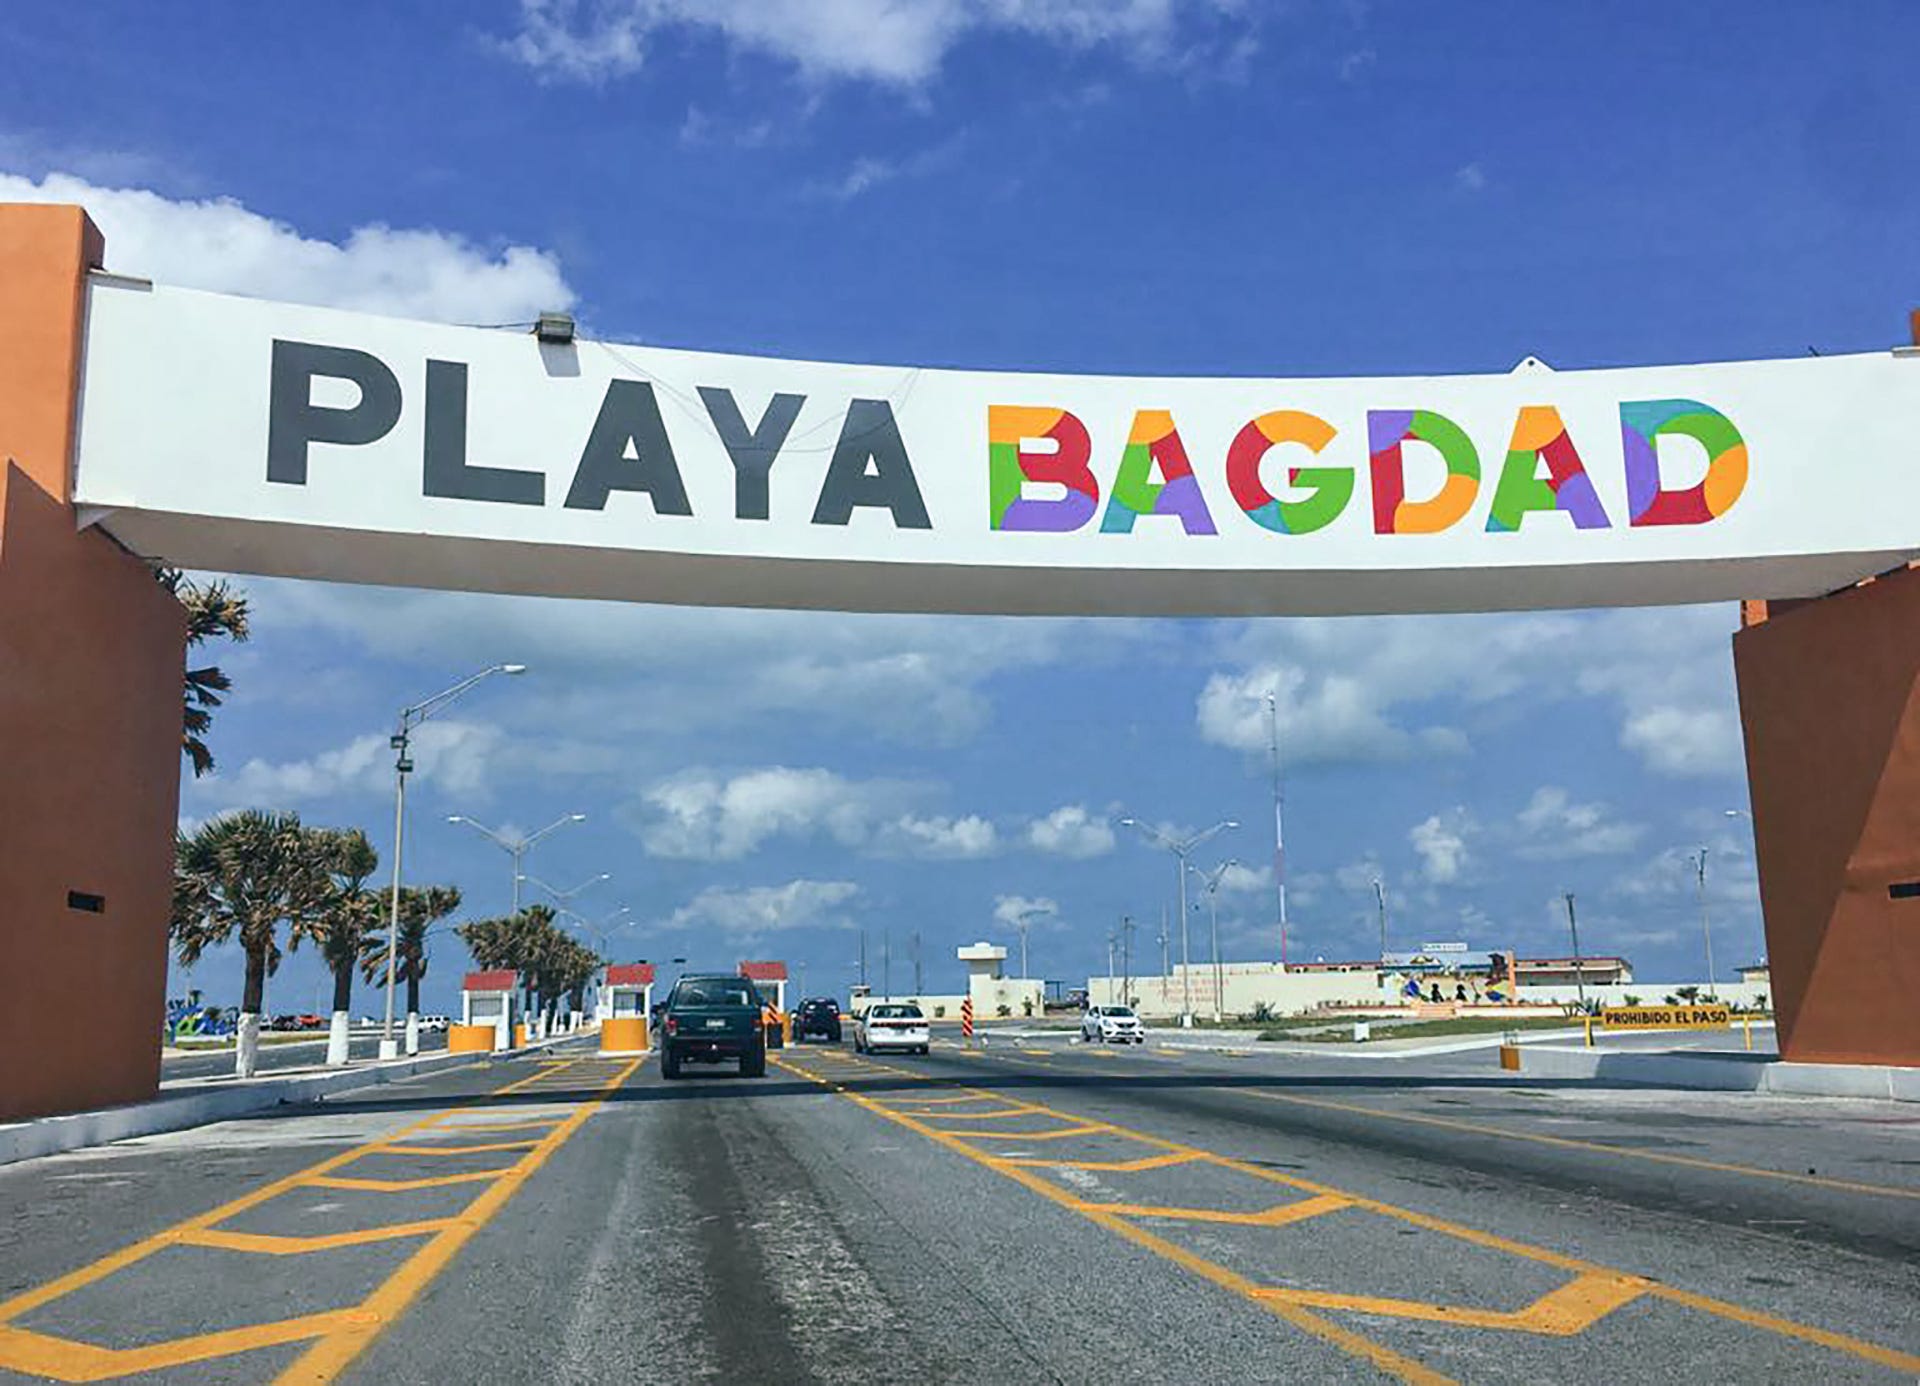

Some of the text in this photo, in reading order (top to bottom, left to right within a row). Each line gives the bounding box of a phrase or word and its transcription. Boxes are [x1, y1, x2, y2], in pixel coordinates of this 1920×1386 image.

[267, 338, 1749, 536] PLAYA BAGDAD
[1605, 1010, 1727, 1024] PROHIBIDO EL PASO
